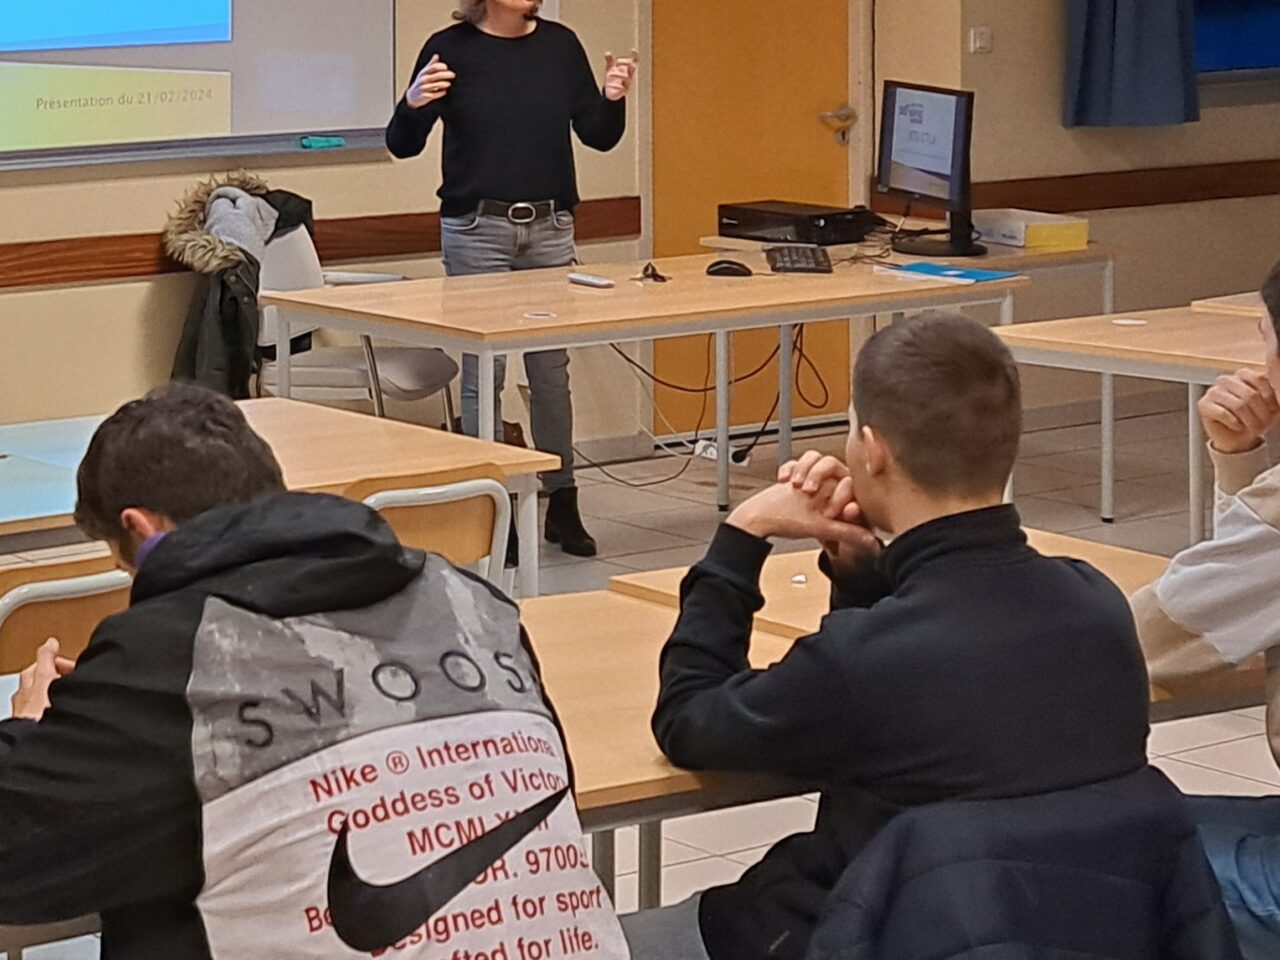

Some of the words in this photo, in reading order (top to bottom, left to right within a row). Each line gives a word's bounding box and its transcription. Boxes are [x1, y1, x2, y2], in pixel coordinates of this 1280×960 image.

[36, 96, 114, 110] Présentation
[117, 93, 133, 106] du
[137, 88, 213, 105] 21/02/2024
[238, 650, 536, 748] SWOOS
[308, 763, 378, 803] Nike
[327, 789, 461, 835] Goddess
[469, 773, 496, 801] of
[511, 894, 546, 920] for
[555, 885, 603, 918] sport
[516, 936, 552, 960] for
[559, 925, 599, 956] life.
